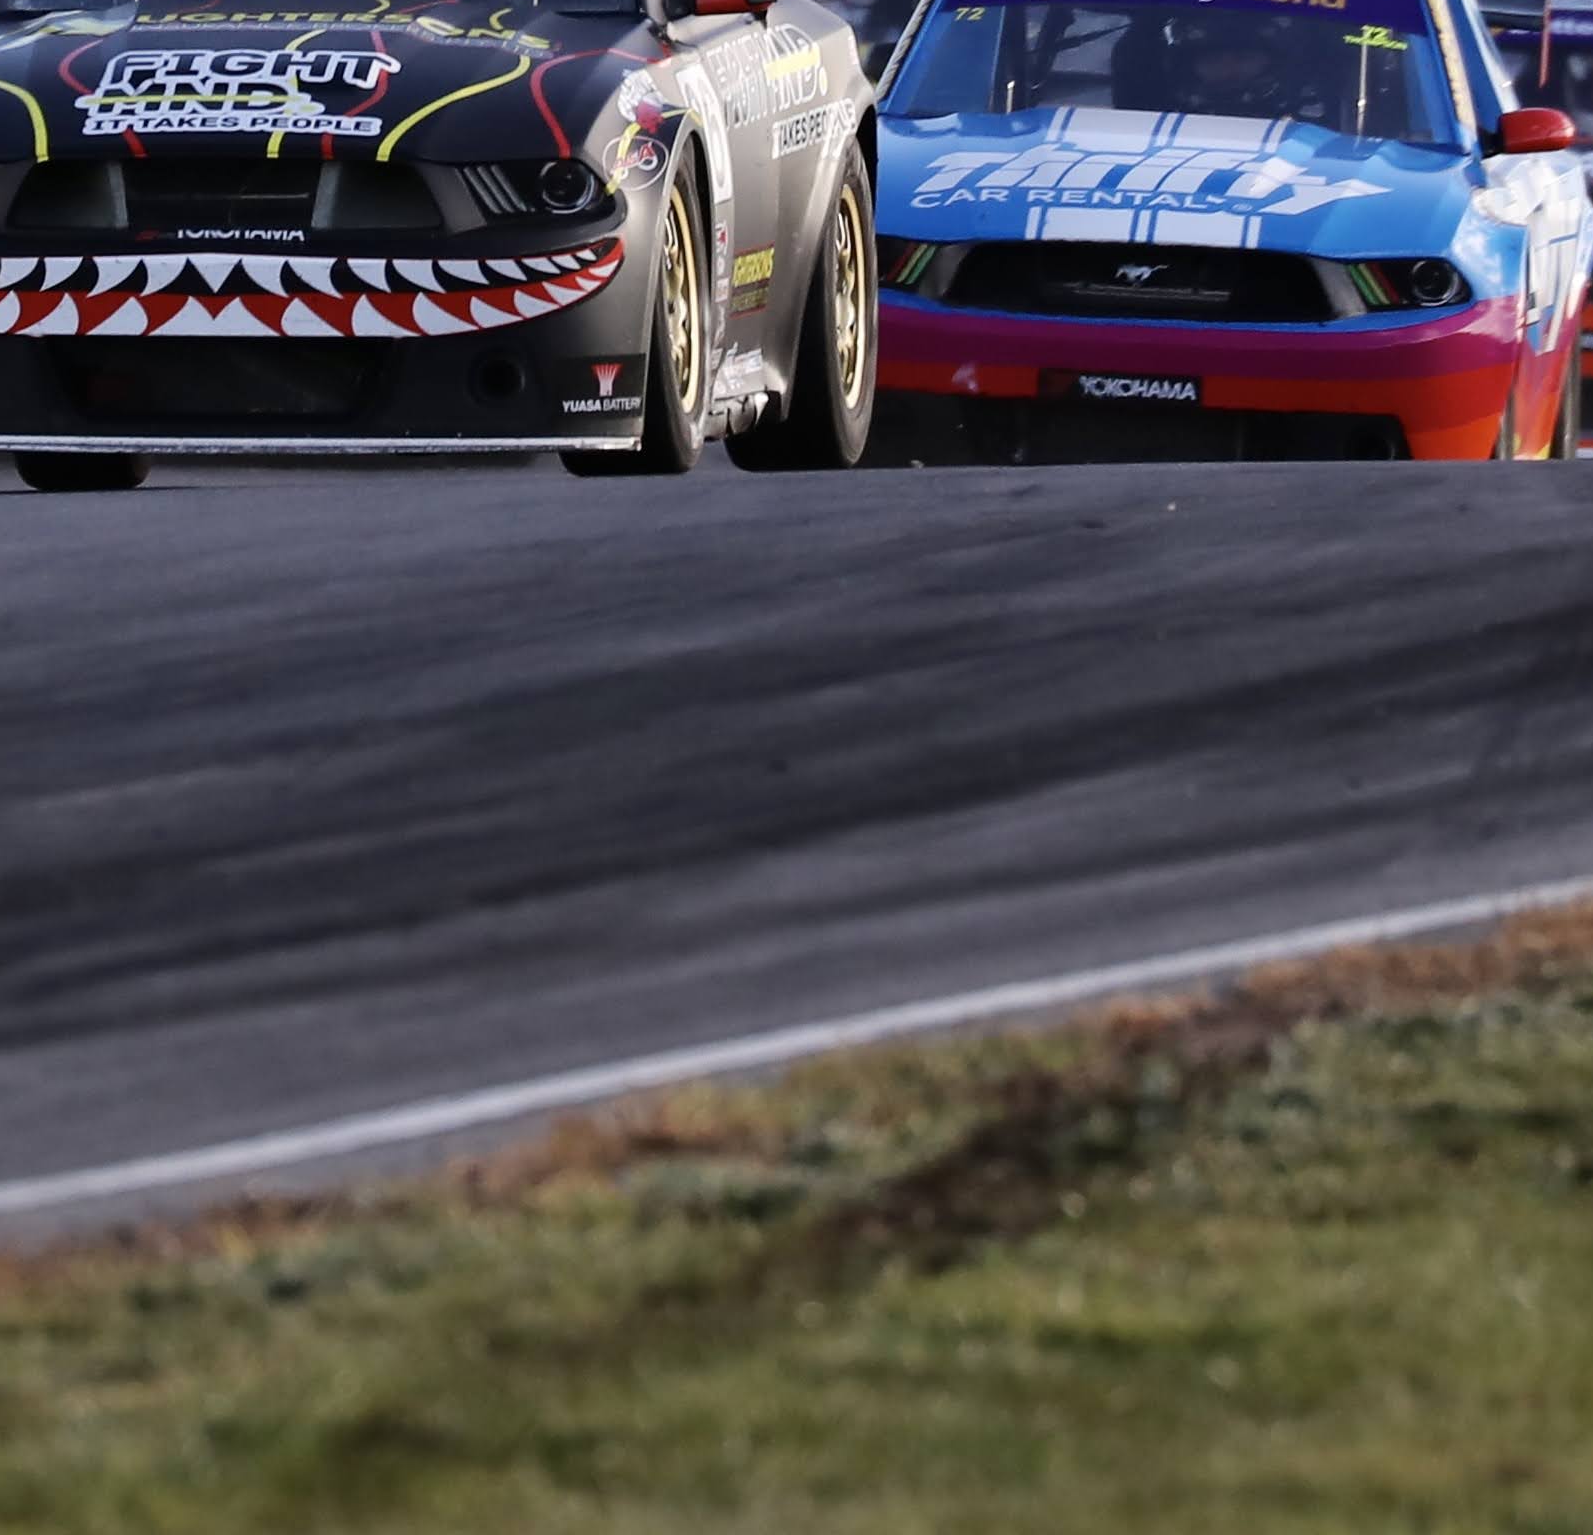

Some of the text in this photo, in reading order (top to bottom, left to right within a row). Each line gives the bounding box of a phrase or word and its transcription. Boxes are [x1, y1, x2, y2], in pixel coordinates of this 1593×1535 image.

[954, 7, 986, 21] 72
[1361, 25, 1390, 39] 72
[103, 51, 399, 87] FIGHT
[93, 116, 373, 132] IT TAKES PEOPLE
[910, 189, 1008, 208] CAR
[1078, 375, 1197, 401] YOKOHAMA
[562, 396, 642, 413] YUASA BATTERY
